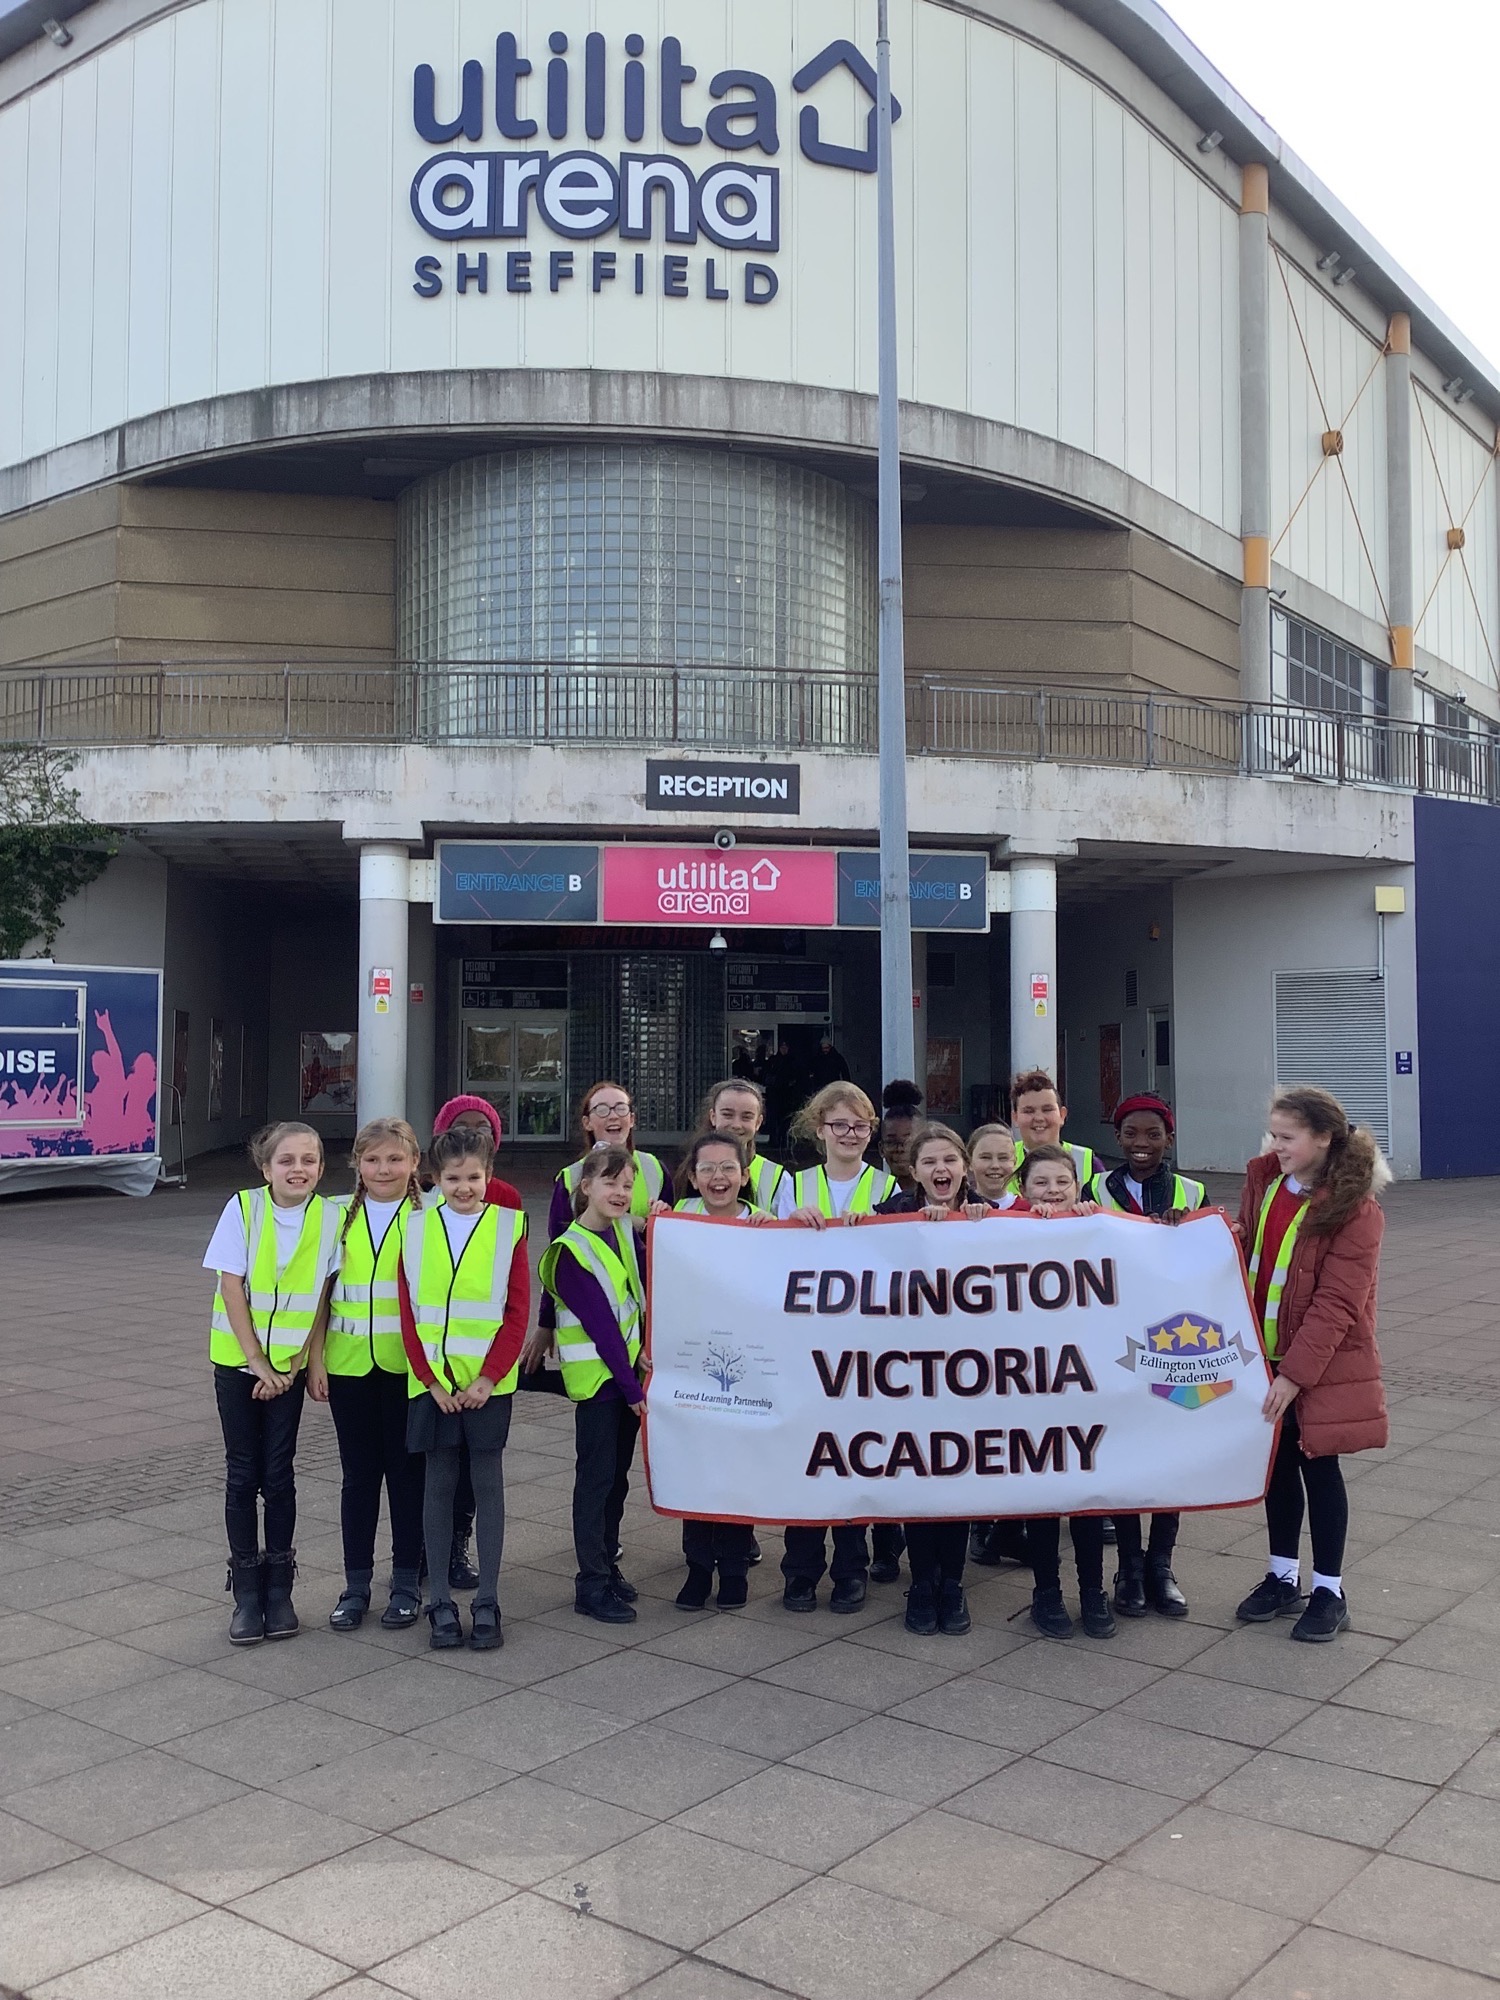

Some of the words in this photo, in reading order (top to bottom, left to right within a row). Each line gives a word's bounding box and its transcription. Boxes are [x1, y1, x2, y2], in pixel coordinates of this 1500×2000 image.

[413, 31, 780, 155] utilita
[410, 150, 780, 252] arena
[413, 251, 779, 304] SHEFFIELD
[659, 775, 788, 799] RECEPTION
[455, 873, 565, 892] ENTRANCE
[568, 874, 582, 892] B
[658, 862, 749, 890] utilita
[854, 880, 956, 900] ENANCE
[959, 883, 972, 900] B
[658, 891, 749, 914] arena
[0, 1050, 56, 1073] ISE
[783, 1257, 1119, 1316] EDLINGTON
[811, 1344, 1096, 1399] VICTORIA
[1139, 1354, 1196, 1373] Edlington
[1198, 1351, 1239, 1370] Victoria
[1164, 1372, 1219, 1383] Academy
[674, 1389, 700, 1401] Exceed
[701, 1392, 732, 1406] Learning
[734, 1395, 773, 1410] Partnership
[805, 1423, 1108, 1479] ACADEMY
